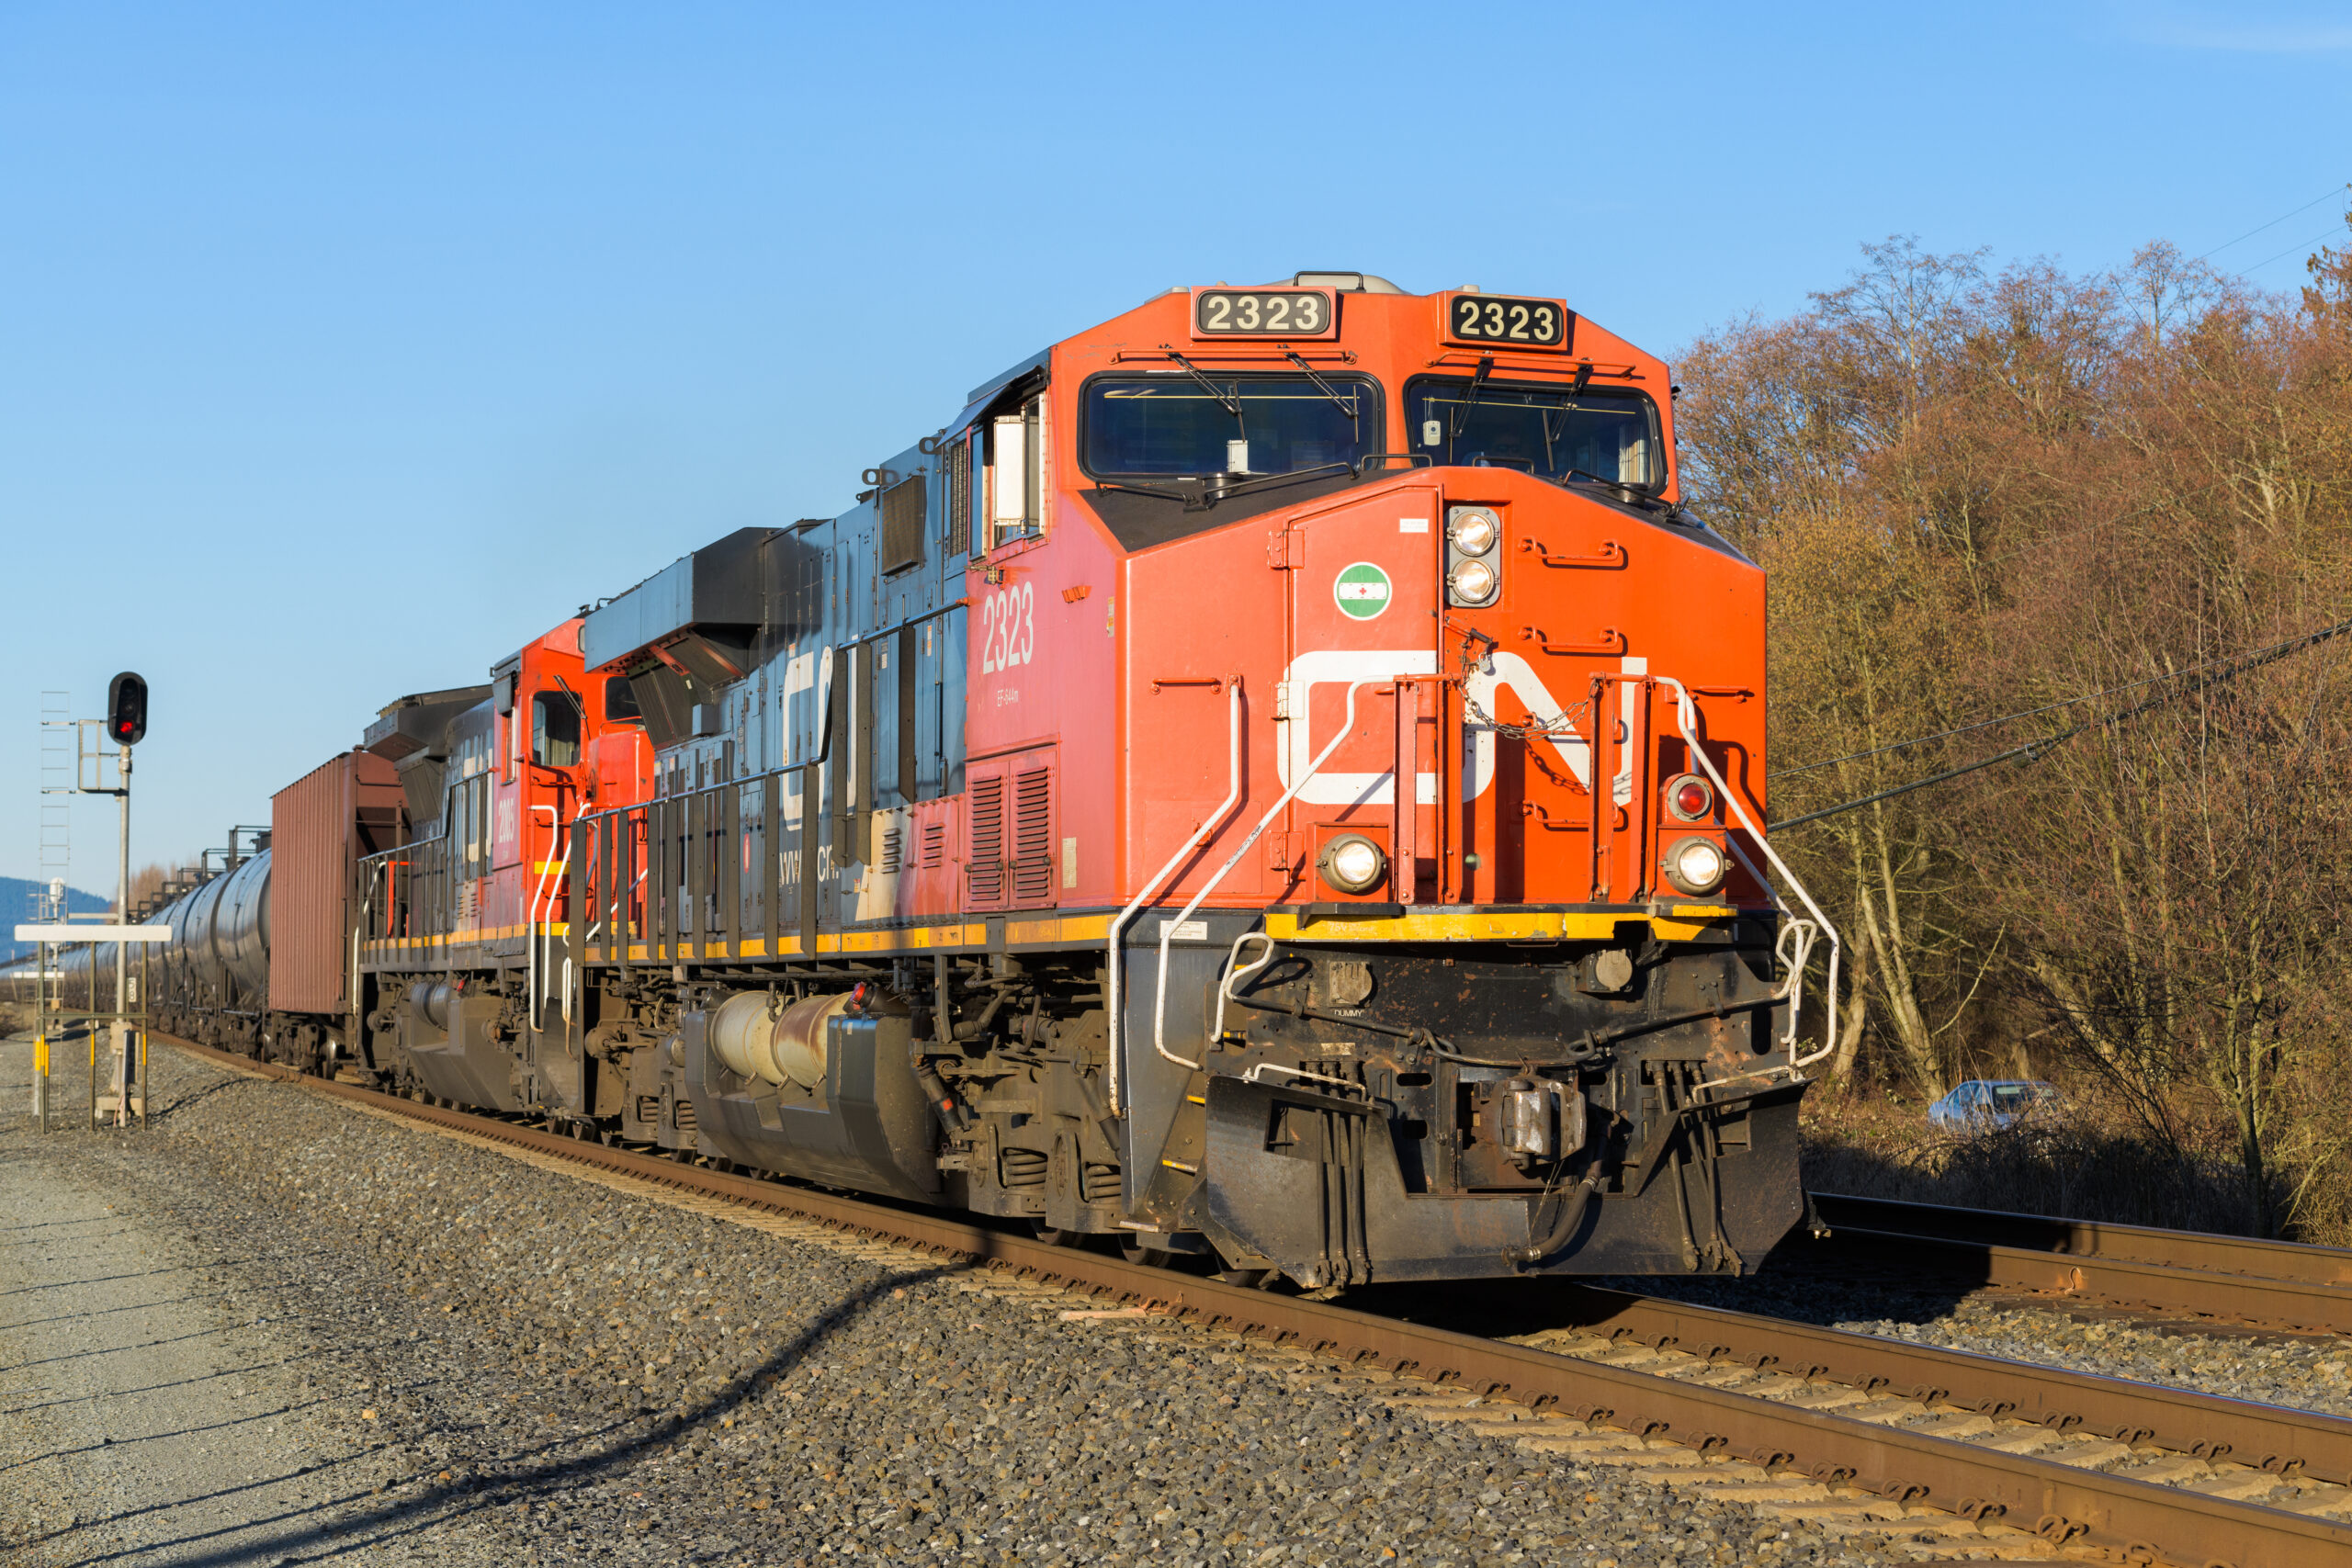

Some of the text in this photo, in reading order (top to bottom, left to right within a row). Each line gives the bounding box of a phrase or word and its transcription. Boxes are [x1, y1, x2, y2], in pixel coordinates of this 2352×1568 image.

[1207, 296, 1319, 330] 2323
[1459, 300, 1554, 341] 2323
[983, 581, 1034, 675] 2323
[1277, 650, 1647, 807] CN
